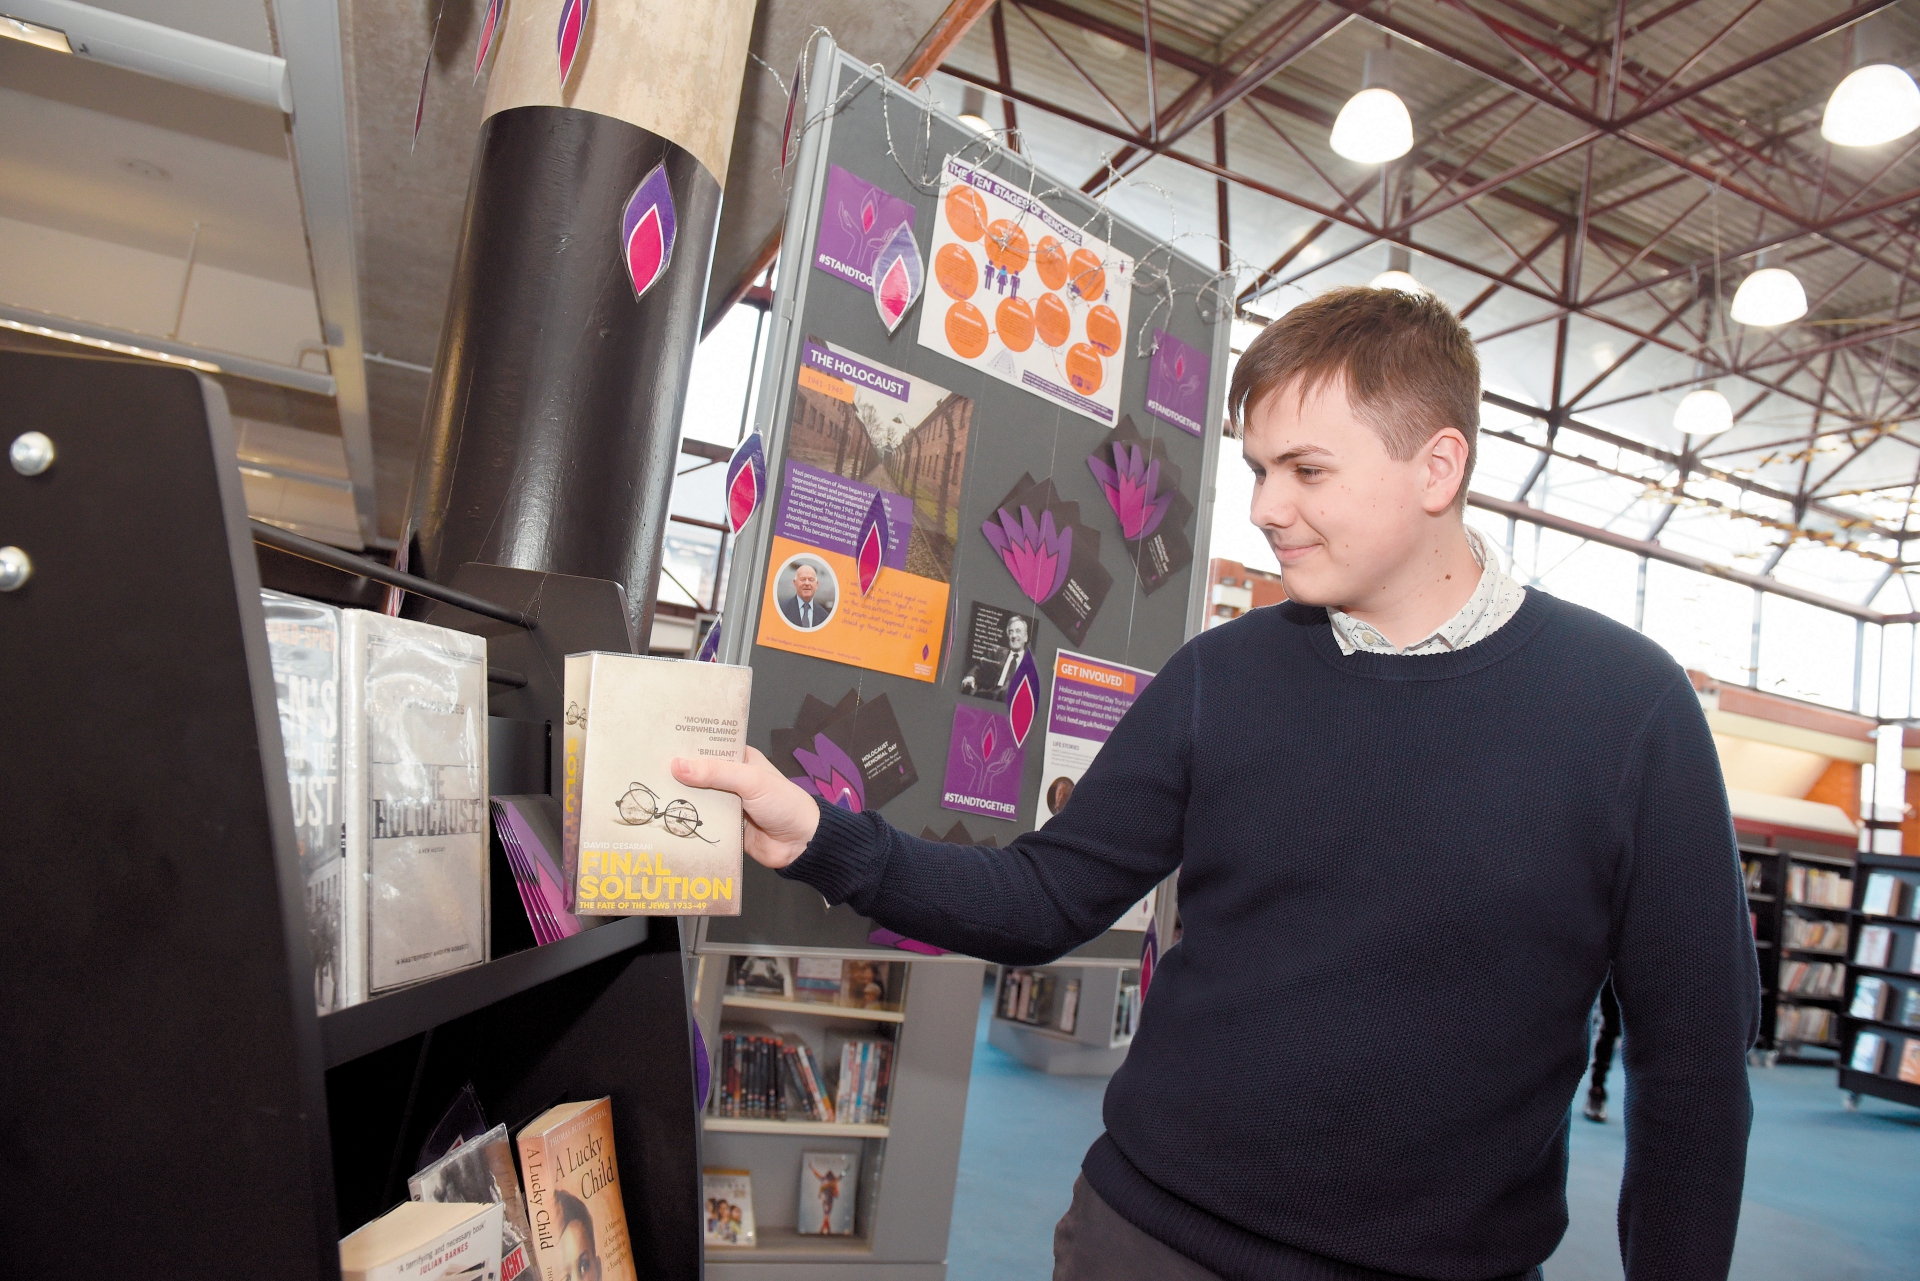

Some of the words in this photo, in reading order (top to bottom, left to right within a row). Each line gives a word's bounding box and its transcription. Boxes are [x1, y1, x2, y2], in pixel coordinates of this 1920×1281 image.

[949, 162, 968, 180] THE
[972, 172, 992, 191] TEN
[993, 185, 1028, 210] STAGES
[1030, 204, 1042, 216] OF
[1042, 211, 1081, 244] GENOCIDE
[818, 253, 873, 286] #STANDTOG
[810, 349, 834, 370] THE
[834, 360, 904, 396] HOLOCAUST
[1148, 399, 1201, 432] #STANDTOGETHER
[792, 468, 804, 476] Nazi
[804, 472, 832, 486] persecution
[849, 486, 862, 496] began
[792, 476, 818, 488] oppressive
[790, 490, 814, 502] European
[829, 502, 842, 510] From
[792, 484, 817, 495] systematic
[826, 494, 845, 504] planned
[845, 500, 864, 510] attempt
[787, 506, 812, 518] murdered
[818, 516, 834, 524] million
[834, 520, 850, 528] Jewish
[850, 525, 860, 533] peop
[810, 521, 842, 534] concentration
[834, 512, 846, 520] Nazis
[802, 525, 812, 534] This
[812, 528, 830, 539] became
[830, 534, 846, 542] known
[1067, 583, 1084, 604] MEMORIAL
[1083, 602, 1092, 611] DAY
[1070, 578, 1090, 601] HOLOCAUST
[1061, 664, 1078, 676] GET
[1079, 668, 1122, 686] INVOLVED
[1058, 685, 1082, 697] Holocaust
[1082, 690, 1104, 702] Memorial
[1104, 696, 1114, 705] Day
[1062, 696, 1076, 704] range
[1081, 700, 1102, 710] resources
[684, 716, 720, 725] 'MOVING
[1056, 714, 1066, 722] Visit
[1066, 716, 1114, 732] hmd.org.uk/holocau
[1066, 704, 1078, 712] learn
[1078, 708, 1091, 716] more
[1091, 710, 1104, 719] about
[675, 724, 740, 736] OVERWHELMING'
[698, 748, 738, 758] 'BRILLIANT'
[862, 740, 888, 762] HOLOCAUST
[864, 750, 888, 768] MEMORIAL
[888, 742, 897, 752] DAY
[1062, 742, 1080, 750] STORIES
[290, 776, 338, 828] UST
[944, 792, 1016, 814] #STANDTOGETHER
[374, 799, 479, 838] HOLOCAUST
[583, 842, 610, 850] DAVID
[612, 842, 653, 850] CESARANI
[582, 852, 672, 876] FINAL
[580, 876, 732, 900] SOLUTION
[549, 1128, 572, 1148] THOMAS
[572, 1108, 607, 1134] BUERGENTHAL
[526, 1148, 540, 1159] A
[556, 1154, 566, 1183] A
[566, 1133, 602, 1174] Lucky
[529, 1164, 546, 1206] Lucky
[581, 1156, 614, 1200] Child
[536, 1210, 554, 1251] Child
[405, 1250, 433, 1271] terrifying
[434, 1245, 445, 1258] and
[446, 1230, 472, 1250] necessary
[420, 1257, 442, 1276] JULIAN
[444, 1242, 469, 1264] BARNES
[501, 1246, 526, 1281] ACHT
